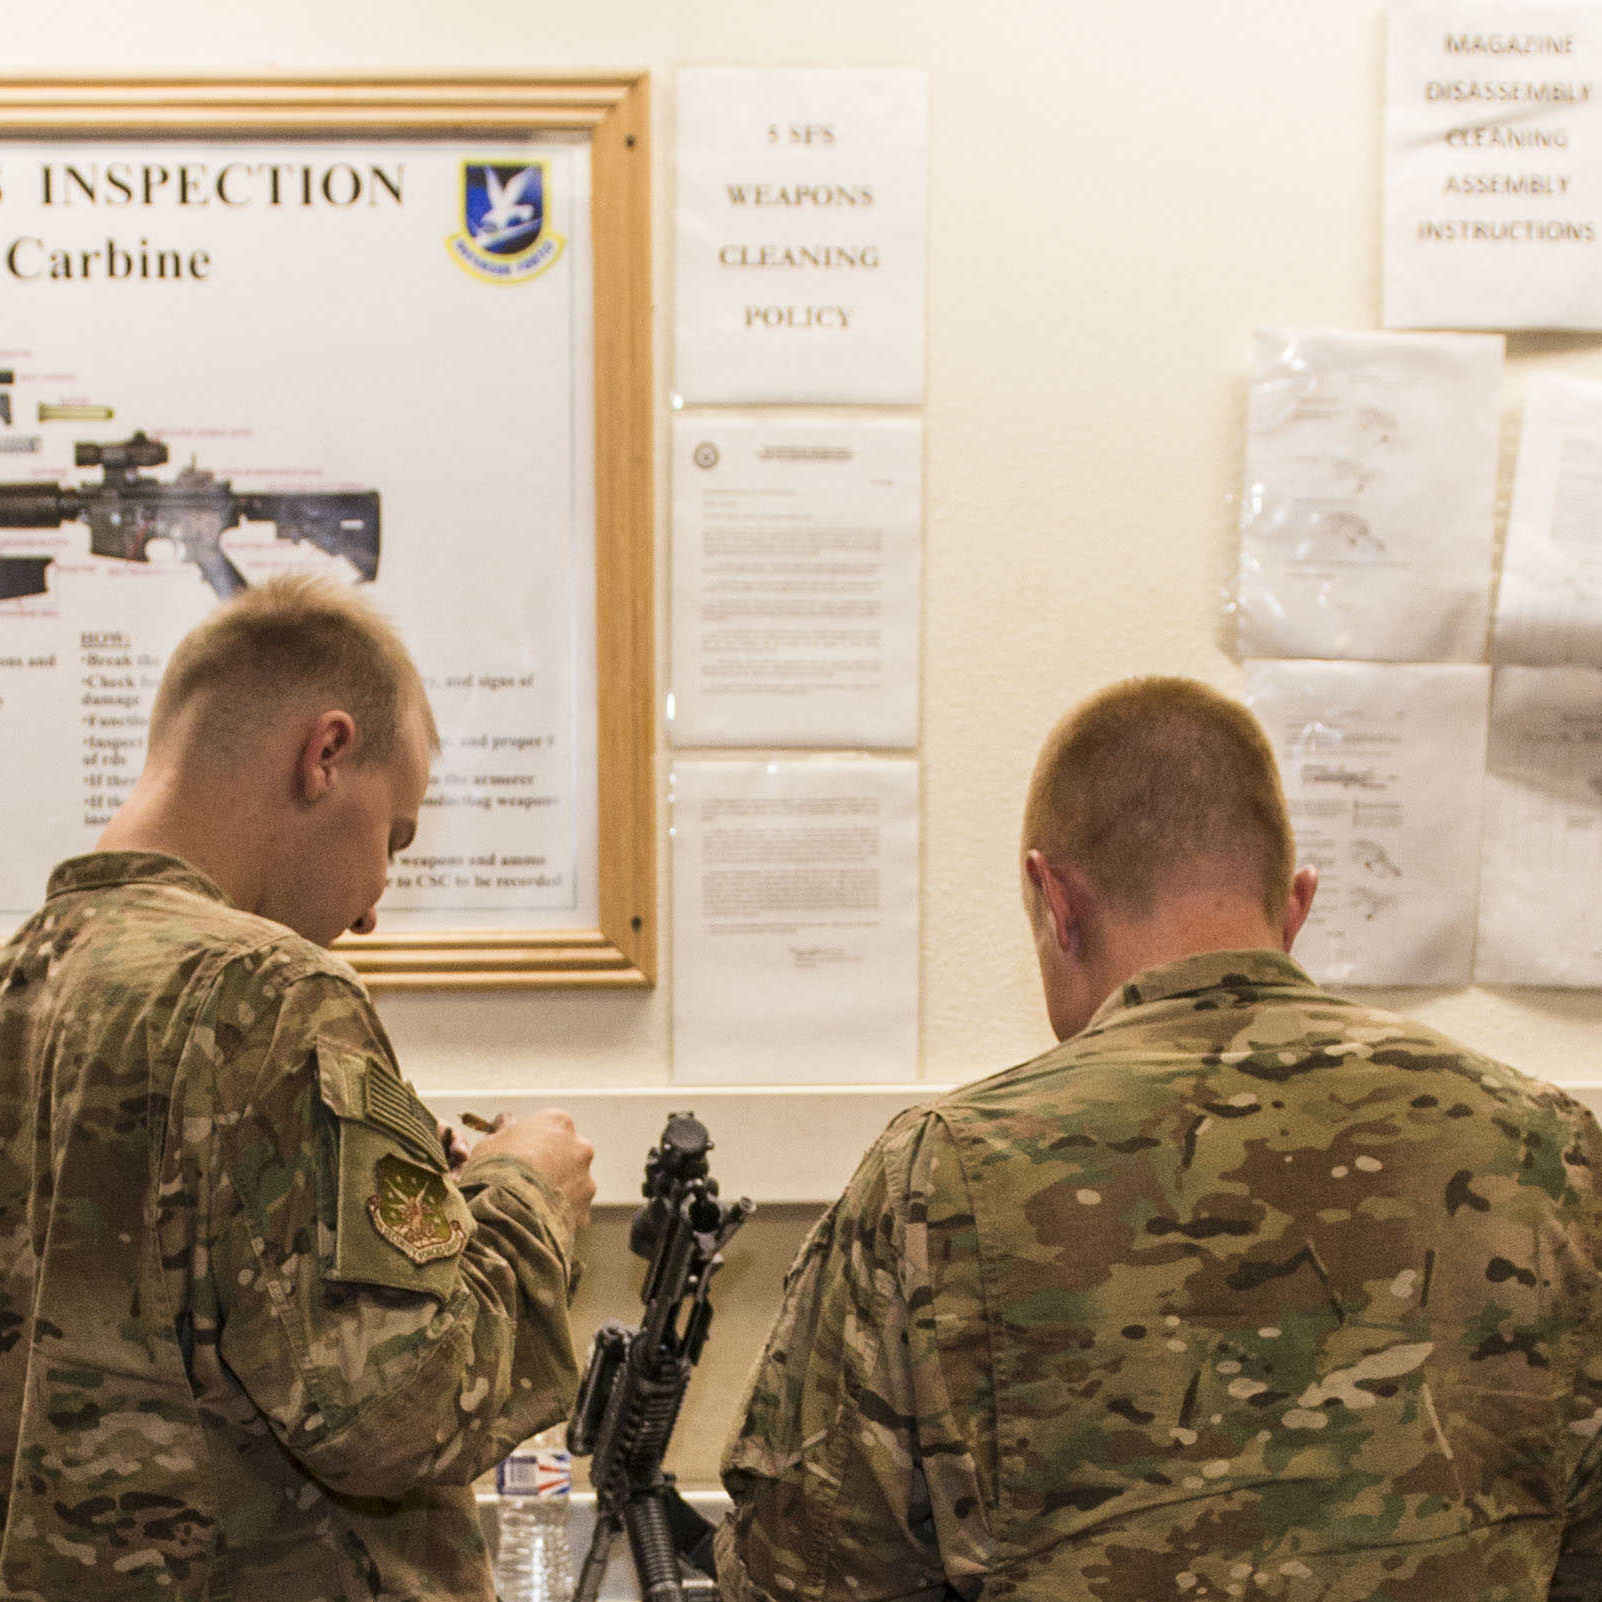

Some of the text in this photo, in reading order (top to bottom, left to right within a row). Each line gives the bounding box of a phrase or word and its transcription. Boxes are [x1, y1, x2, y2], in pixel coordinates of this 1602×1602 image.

[1443, 33, 1577, 55] MAGAZINE
[1424, 80, 1593, 102] DISASSEMBLY
[788, 122, 835, 145] SFS
[1445, 127, 1571, 148] CLEANING
[40, 162, 406, 206] INSPECTION
[726, 182, 874, 207] WEAPONS
[1443, 173, 1571, 194] ASSEMBLY
[1415, 219, 1597, 241] INSTRUCTIONS
[4, 237, 211, 280] Carbine
[718, 244, 880, 269] CLEANING
[743, 305, 854, 329] POLICY
